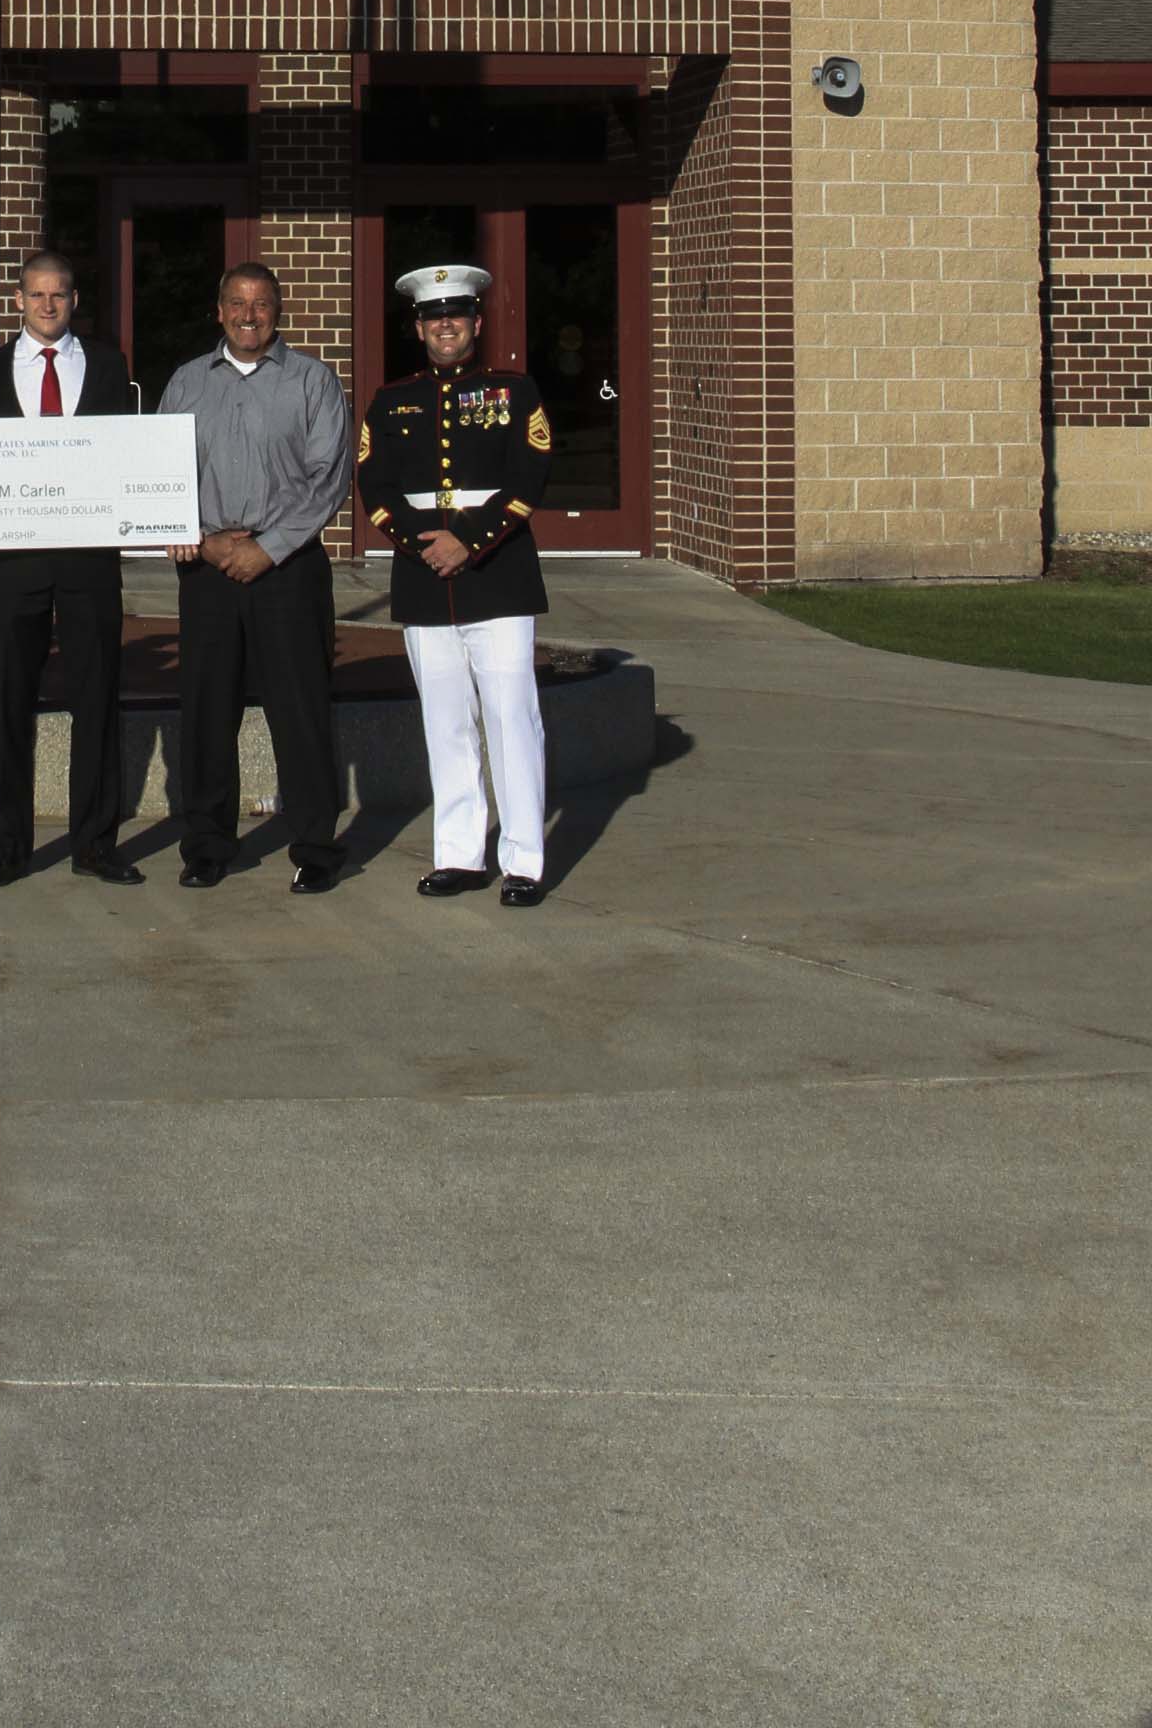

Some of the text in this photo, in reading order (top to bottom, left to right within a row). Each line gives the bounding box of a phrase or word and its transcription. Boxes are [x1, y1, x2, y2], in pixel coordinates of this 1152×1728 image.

[28, 439, 60, 448] MARINE
[63, 438, 92, 447] CORPS
[20, 483, 65, 498] Carlen
[17, 505, 69, 516] THOUSAND
[71, 504, 113, 515] DOLLARS
